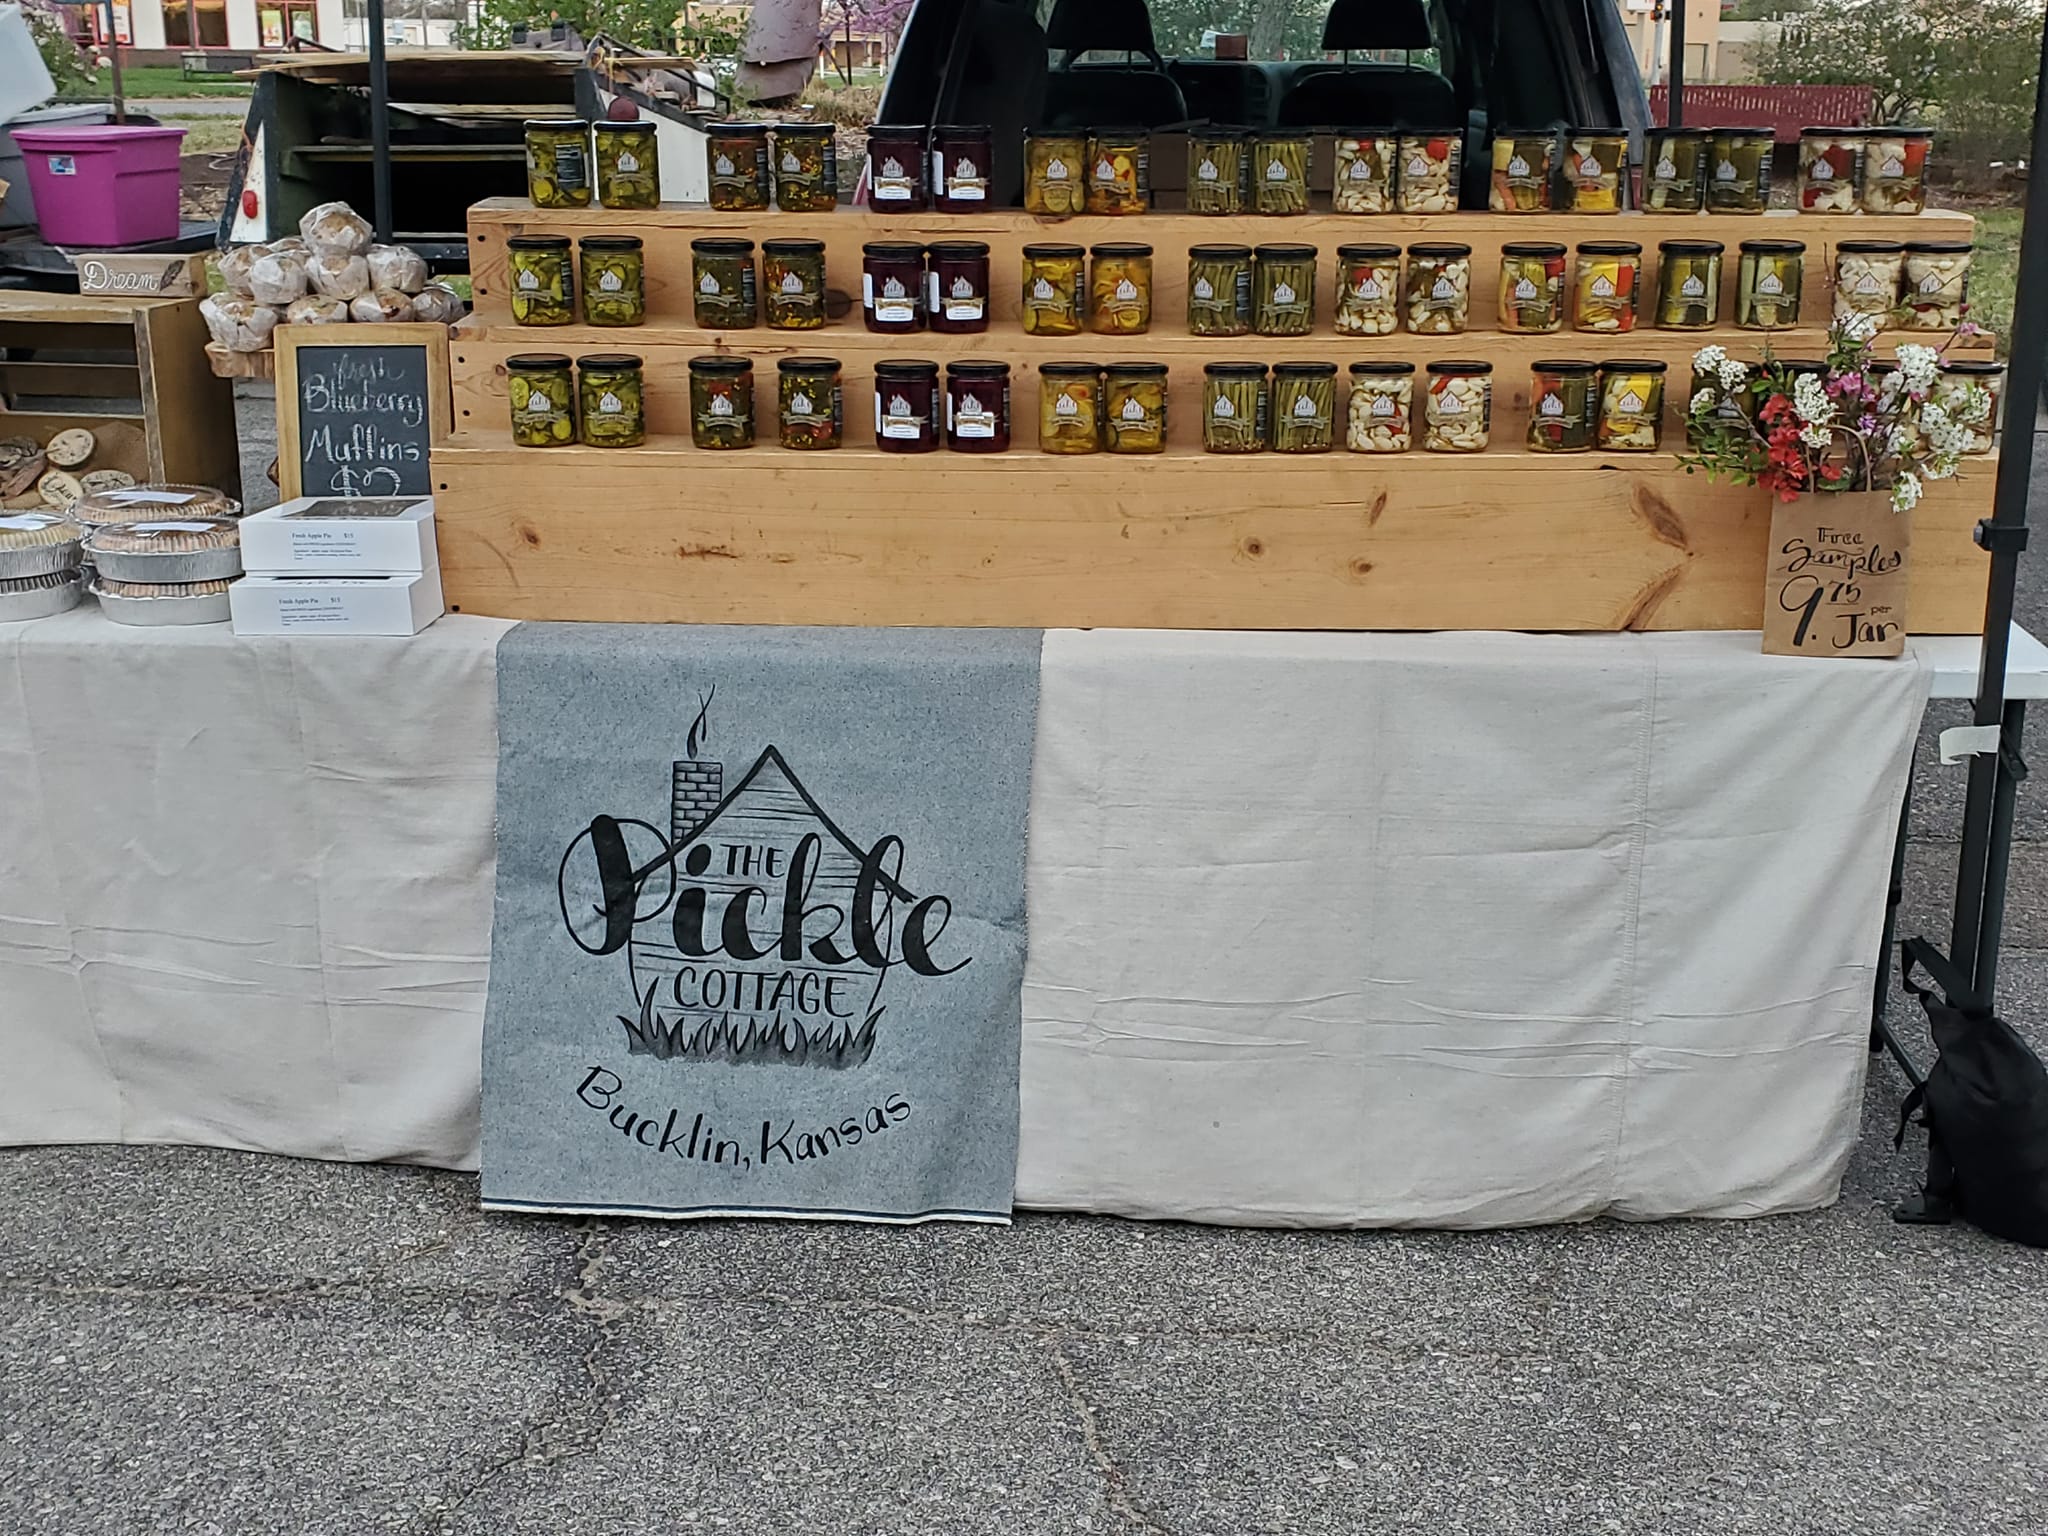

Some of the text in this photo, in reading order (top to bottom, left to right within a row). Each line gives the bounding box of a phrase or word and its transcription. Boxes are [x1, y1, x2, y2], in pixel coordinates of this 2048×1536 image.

[83, 261, 158, 290] Dream
[302, 373, 424, 428] Blueberry
[305, 423, 420, 465] Muffins
[307, 532, 322, 540] Apple
[1817, 527, 1864, 545] Free
[1781, 538, 1902, 580] Samples
[294, 598, 309, 606] Apple
[1870, 605, 1892, 616] per
[1832, 612, 1898, 649] Jar
[719, 843, 785, 878] THE
[558, 814, 973, 976] Pickle
[673, 966, 854, 1018] COTTAGE
[760, 1093, 911, 1165] Kansas
